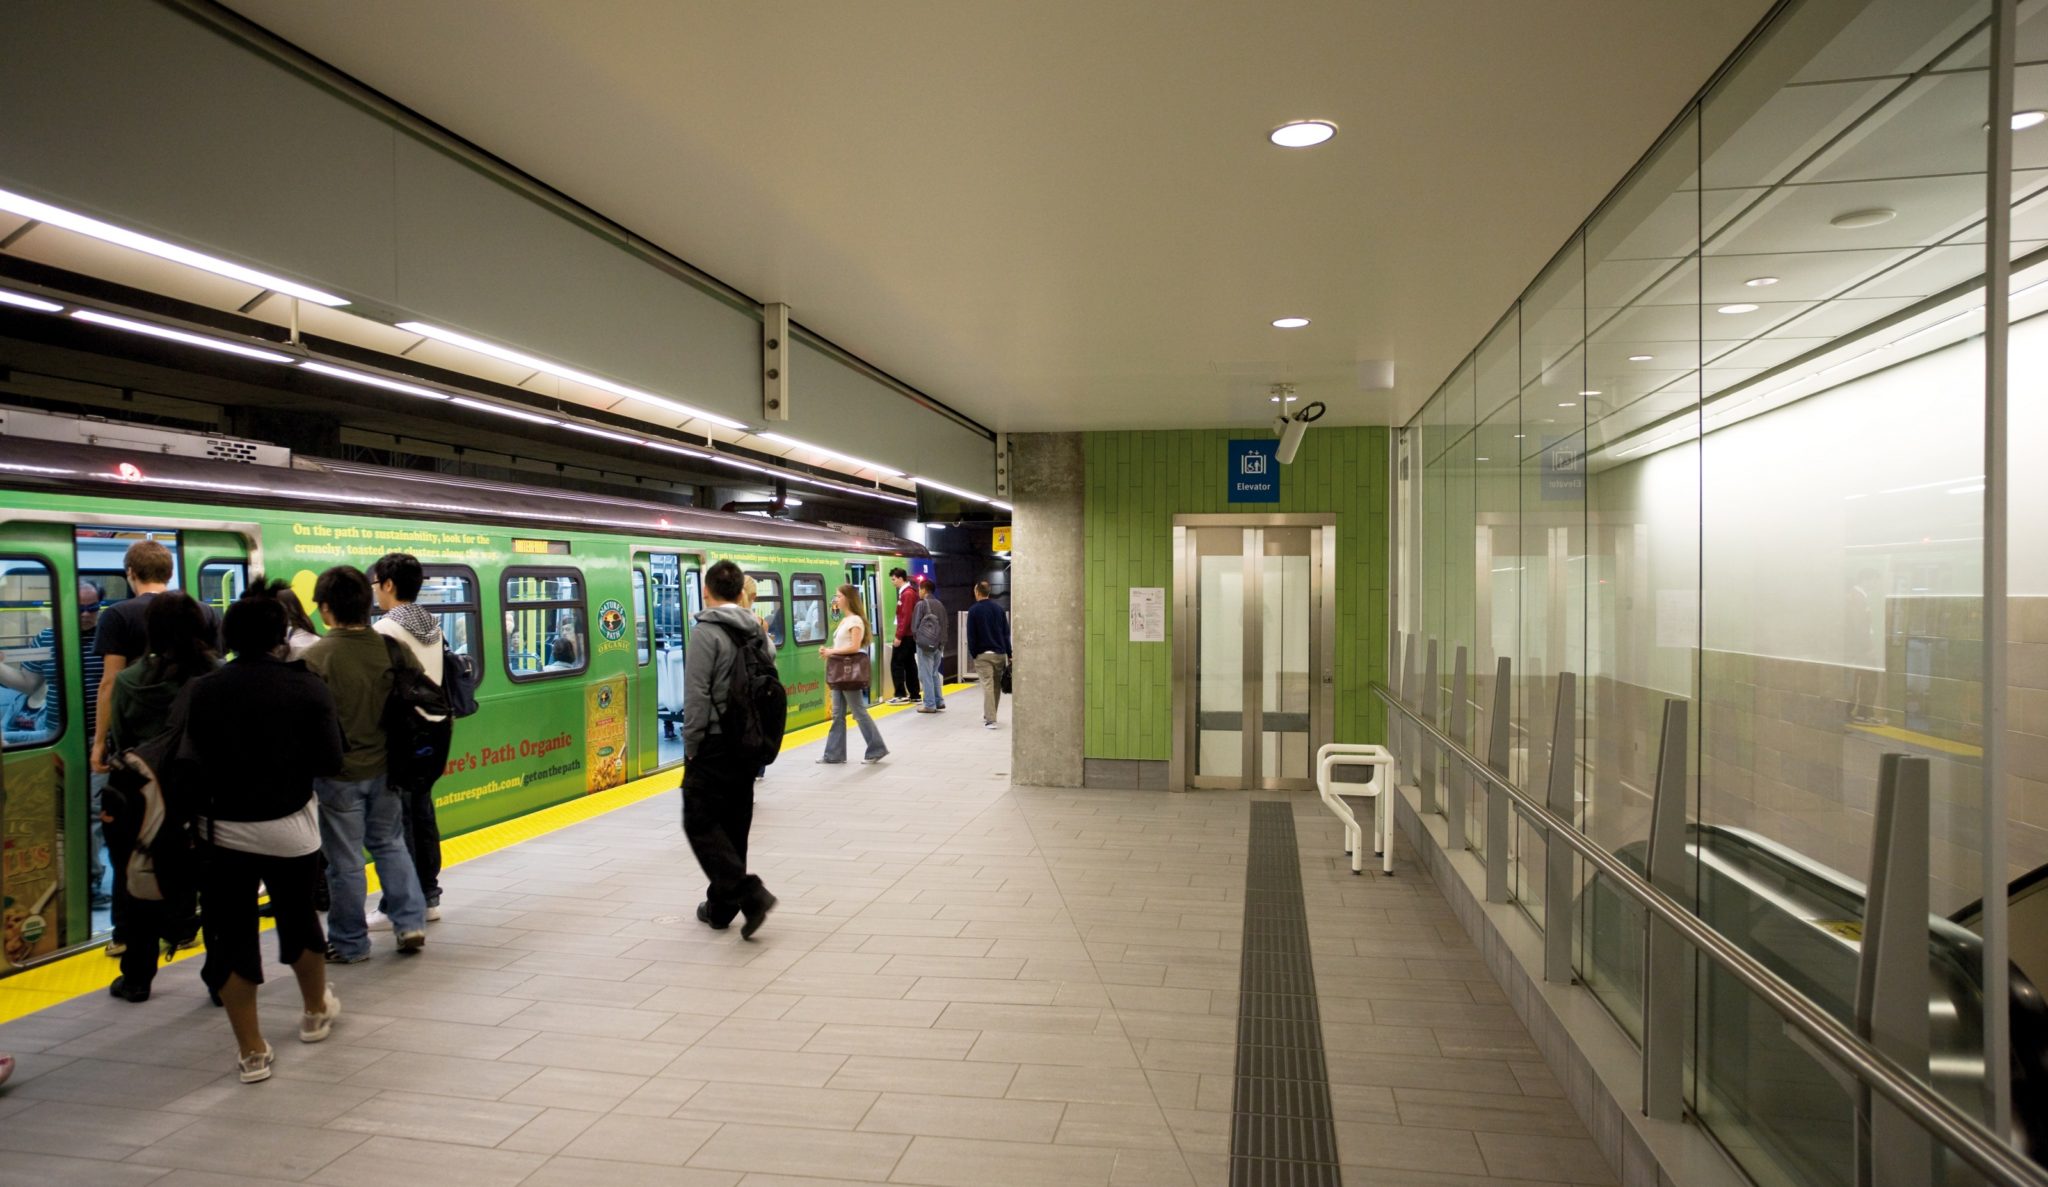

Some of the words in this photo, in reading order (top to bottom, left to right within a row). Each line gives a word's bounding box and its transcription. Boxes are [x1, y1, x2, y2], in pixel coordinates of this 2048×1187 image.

[1236, 482, 1271, 491] Elevator
[293, 523, 311, 535] On
[313, 525, 332, 536] the
[334, 527, 359, 539] path
[361, 529, 373, 538] to
[374, 529, 441, 544] sustainability,
[441, 532, 461, 543] look
[462, 534, 475, 544] for
[476, 534, 490, 545] the
[294, 543, 345, 556] crunchy,
[347, 544, 385, 555] toasted
[606, 631, 620, 640] PATH
[598, 640, 630, 653] ORGANIC
[481, 743, 516, 767] Path
[519, 732, 572, 758] Organic
[435, 759, 581, 808] naturespath.com/getonthepath
